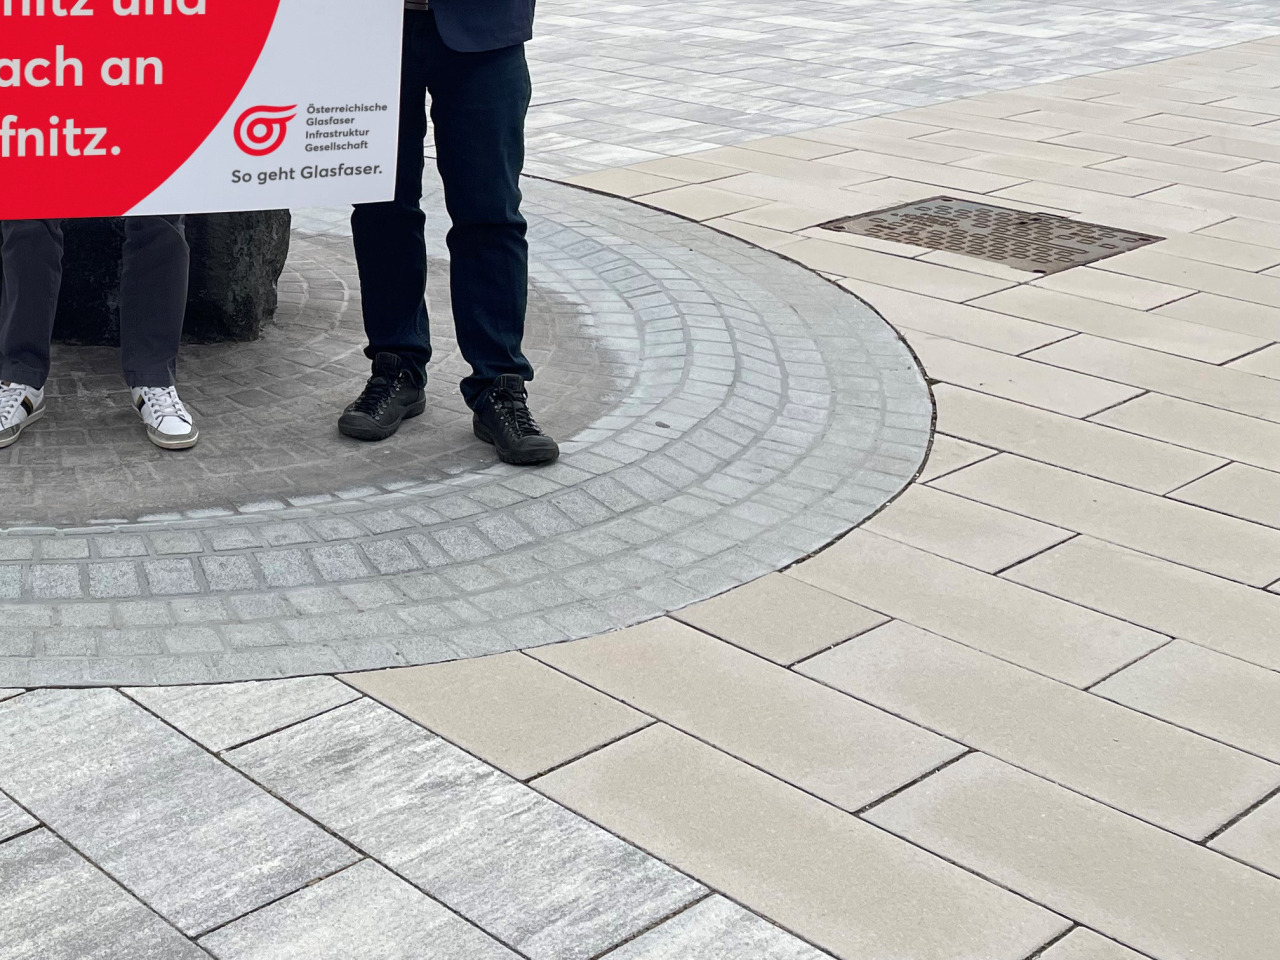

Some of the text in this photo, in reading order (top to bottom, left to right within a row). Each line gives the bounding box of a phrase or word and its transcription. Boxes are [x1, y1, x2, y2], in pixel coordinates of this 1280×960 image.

[100, 56, 163, 87] an
[306, 102, 388, 115] Österreichische
[305, 116, 356, 127] Glasfaser
[304, 127, 370, 140] Infrastruktur
[304, 140, 369, 153] Gesellschaft
[231, 162, 383, 186] So geht Glasfaser.
